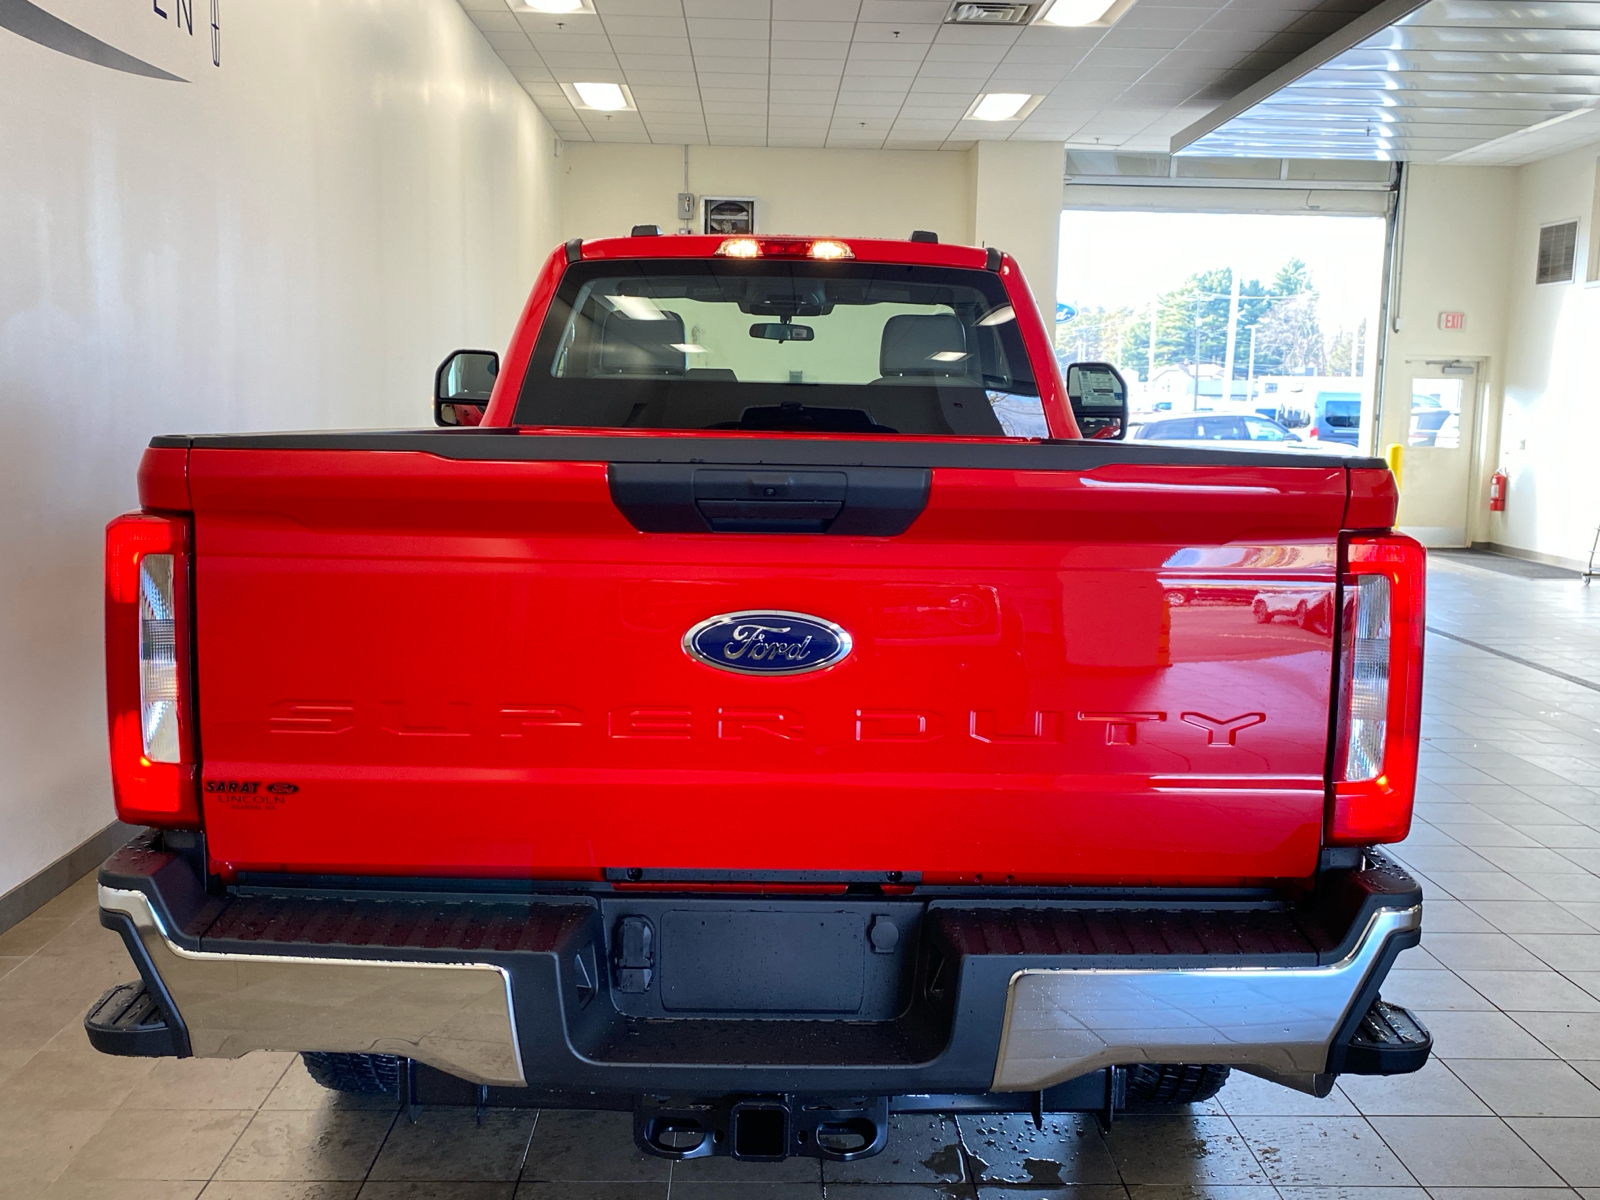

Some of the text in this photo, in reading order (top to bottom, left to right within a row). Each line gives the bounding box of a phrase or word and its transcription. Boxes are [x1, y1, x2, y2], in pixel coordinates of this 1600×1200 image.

[1445, 313, 1464, 329] EXIT
[723, 624, 812, 661] Ford
[268, 699, 1267, 748] SUPER DUTY
[205, 780, 297, 794] SARAT Ford
[218, 795, 285, 804] LINCOLN
